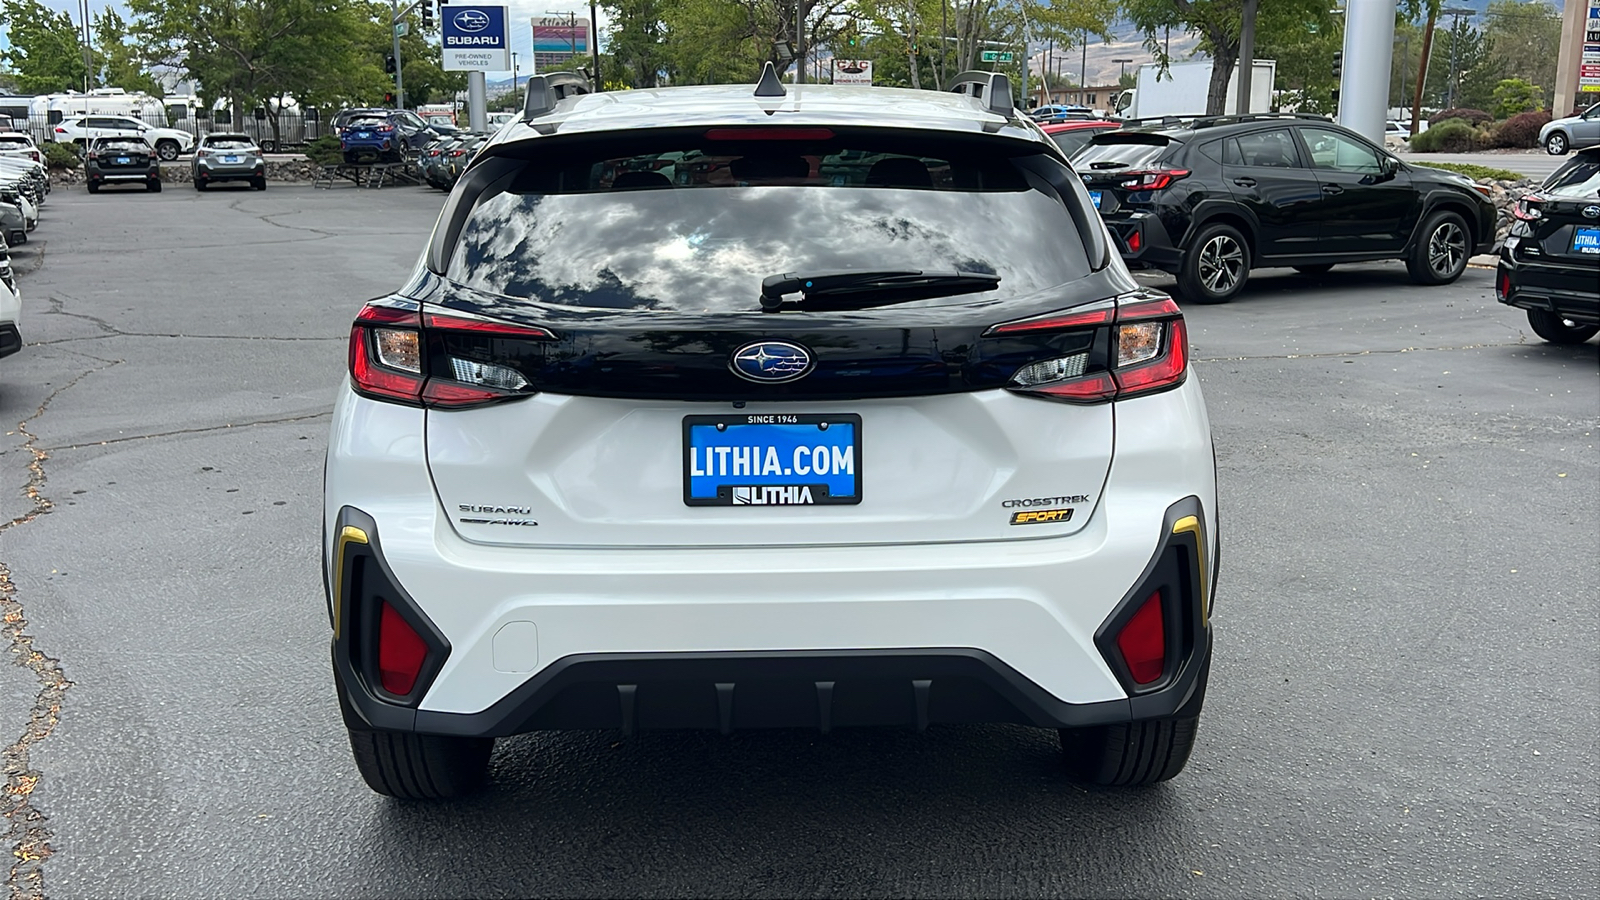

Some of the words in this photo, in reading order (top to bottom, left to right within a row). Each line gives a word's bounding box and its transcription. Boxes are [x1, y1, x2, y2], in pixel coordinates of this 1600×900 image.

[447, 36, 499, 45] SUBARU
[1575, 235, 1600, 246] LITHIA.
[777, 415, 798, 423] 1946
[690, 446, 854, 476] LITHIA.COM
[751, 486, 814, 505] LITHIA
[1002, 494, 1090, 508] CROSSTREK
[459, 503, 531, 514] SUBARU
[1015, 510, 1068, 523] SPORT
